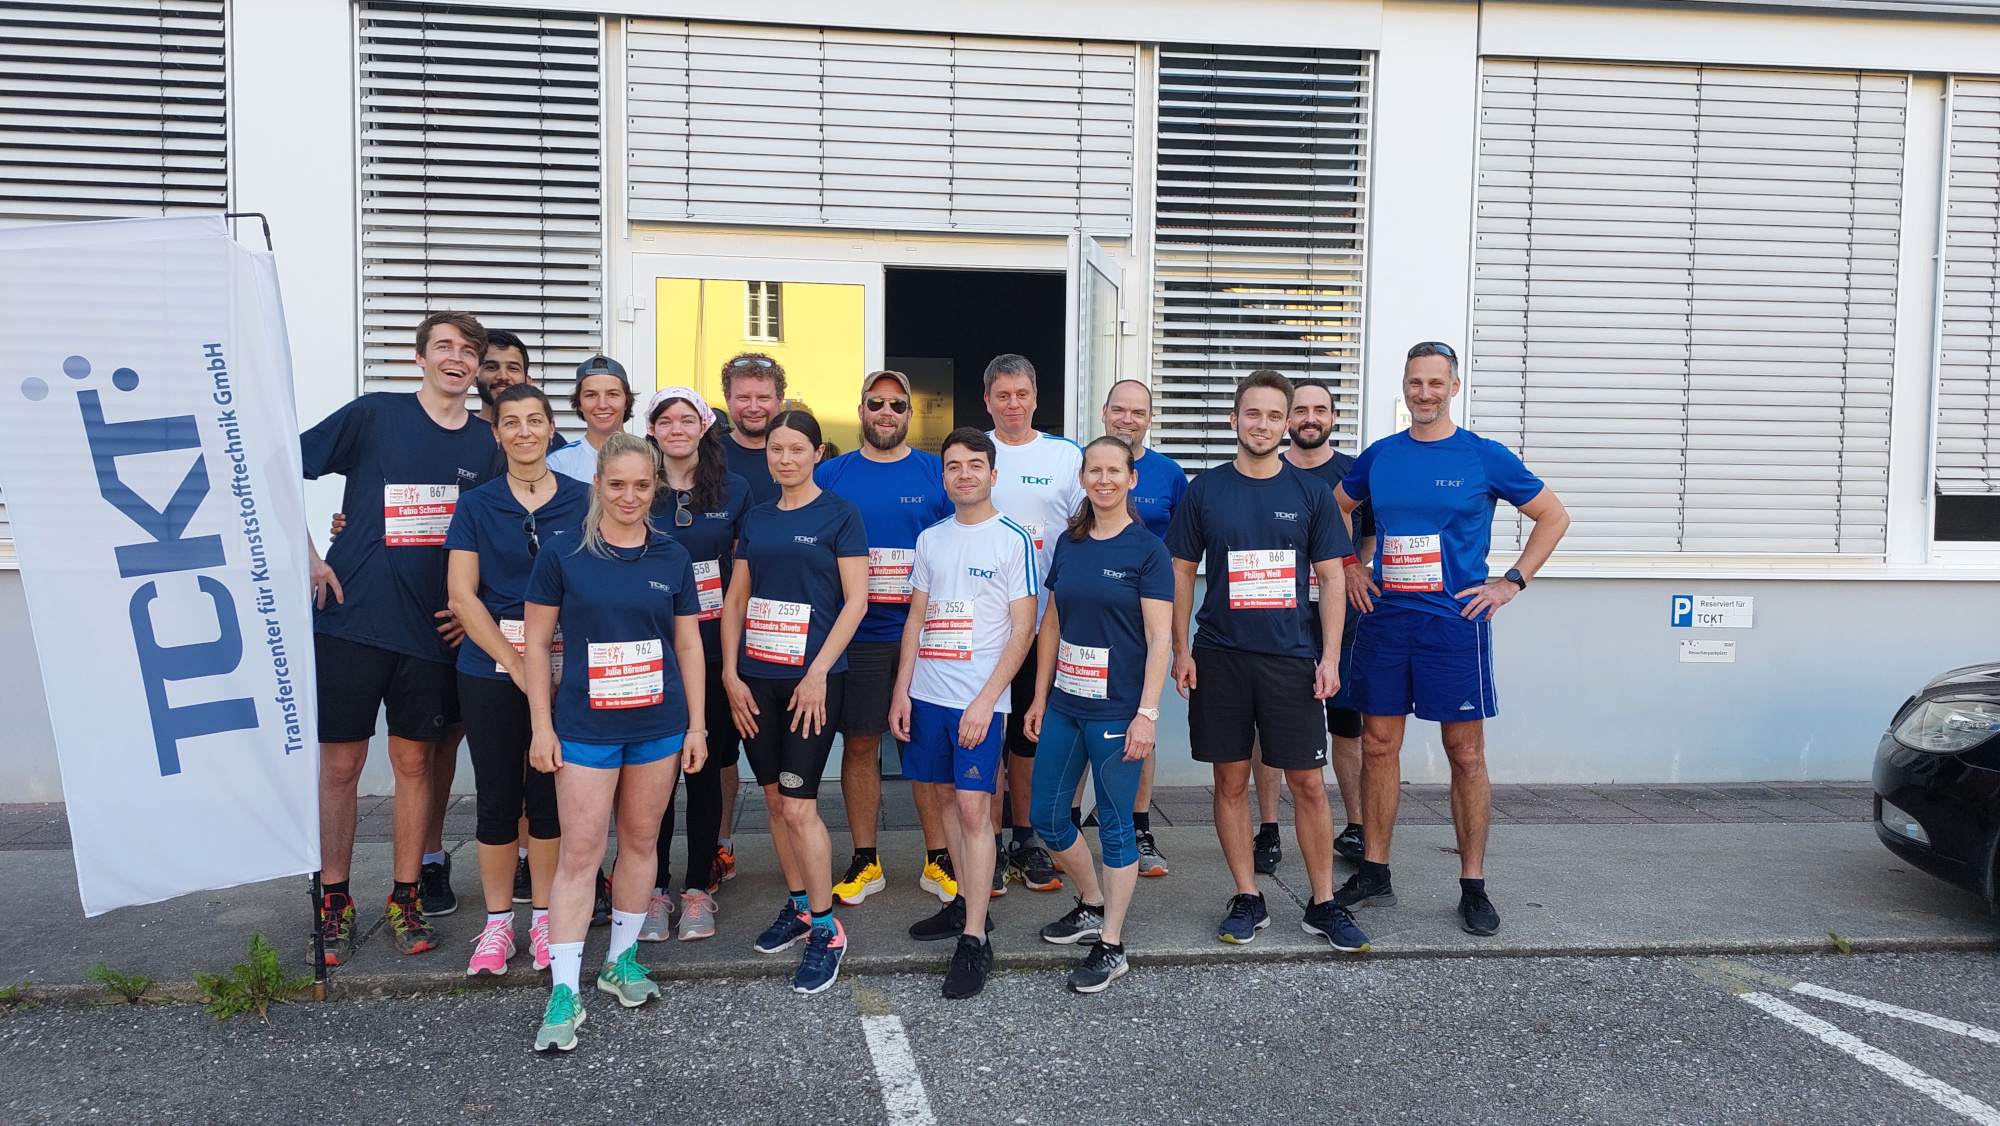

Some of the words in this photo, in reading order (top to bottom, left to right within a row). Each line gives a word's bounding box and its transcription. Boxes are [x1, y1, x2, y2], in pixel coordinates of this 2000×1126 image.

[202, 343, 234, 407] GmbH
[1020, 475, 1053, 486] TCKT
[1434, 479, 1463, 488] TCKT
[217, 408, 270, 582] Kunststofftechnik
[430, 486, 446, 498] 867
[899, 496, 924, 504] TCKT
[398, 506, 418, 516] Fabio
[1409, 536, 1429, 549] 2557
[891, 550, 905, 560] 871
[1269, 551, 1285, 562] 868
[1391, 556, 1403, 564] Karl
[693, 562, 710, 576] 558
[968, 567, 997, 579] TCKT
[1243, 571, 1265, 580] Philipp
[76, 388, 260, 777] TCKT
[256, 586, 277, 615] für
[1700, 600, 1735, 608] Reserviert
[1735, 600, 1746, 608] für
[778, 603, 801, 616] 2559
[945, 601, 964, 613] 2552
[1674, 597, 1691, 625] P
[1697, 614, 1724, 624] TCKT
[780, 623, 801, 633] Shvets
[635, 642, 652, 656] 962
[1079, 648, 1096, 660] 964
[604, 666, 622, 677] Julia
[622, 664, 651, 675] Börnsen
[1075, 666, 1101, 677] Schwarz
[265, 618, 303, 756] Transfercenter
